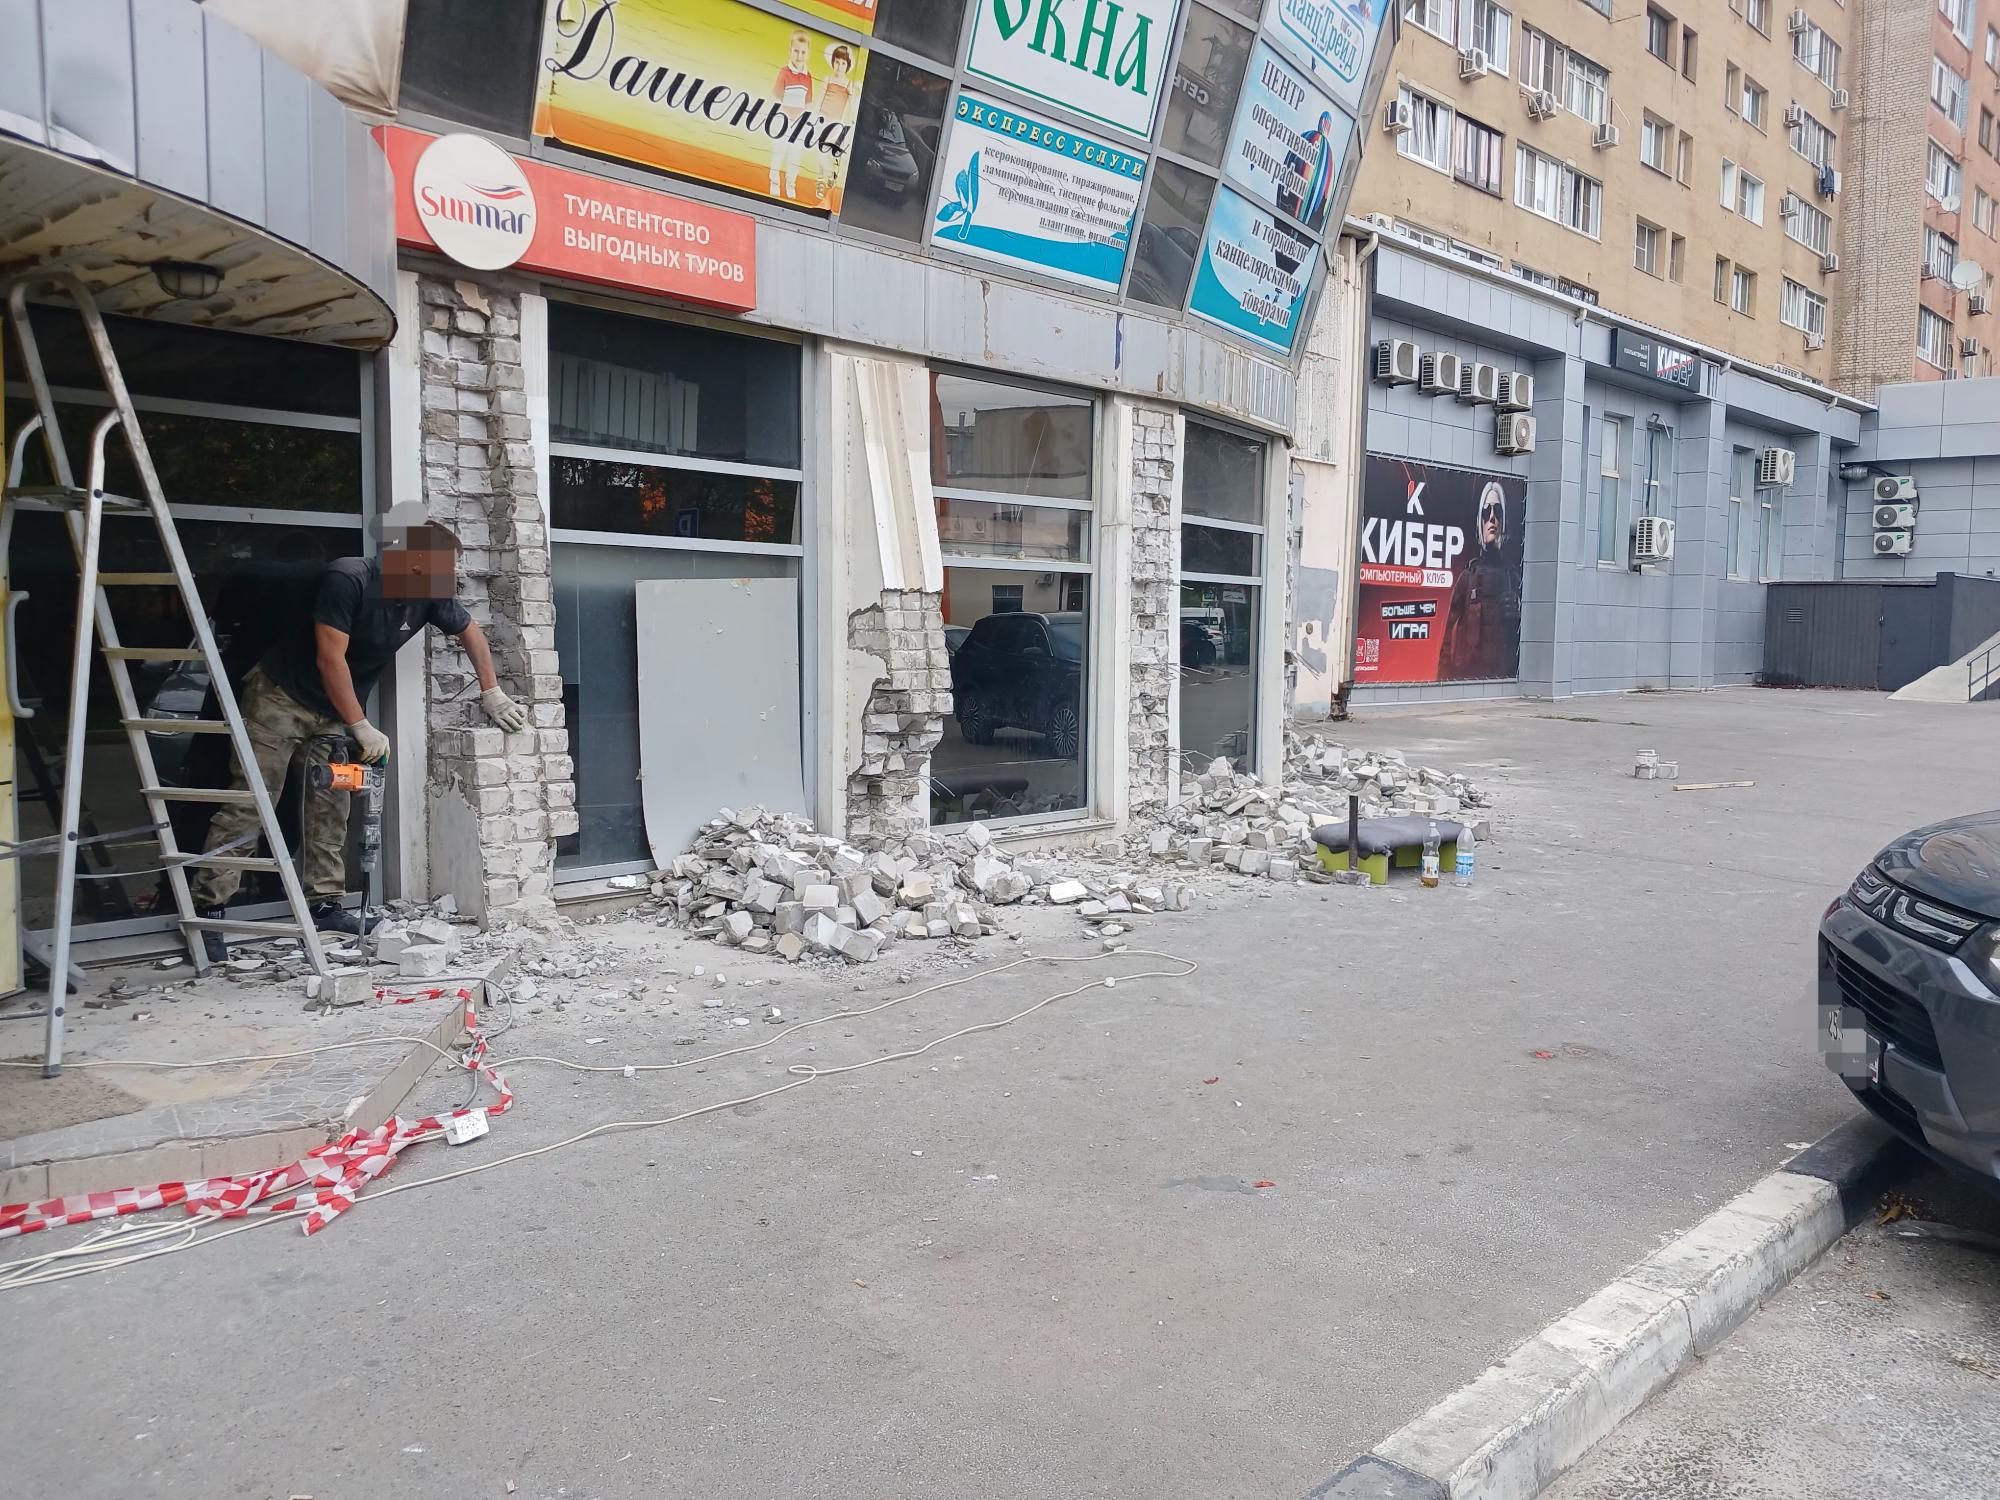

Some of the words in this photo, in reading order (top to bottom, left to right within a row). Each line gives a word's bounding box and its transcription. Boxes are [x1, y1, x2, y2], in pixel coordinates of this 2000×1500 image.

[545, 0, 851, 157] Дашенька
[1261, 59, 1305, 111] ЦЕНТР
[957, 101, 1065, 151] ЭКСПРЕСС
[1072, 140, 1145, 177] УСЛУГИ
[1252, 103, 1320, 166] оперативной
[982, 164, 1056, 195] ламинирование,
[1058, 187, 1096, 208] тиснение
[984, 146, 1069, 184] ксерокопирование,
[1071, 173, 1135, 203] тиражирование,
[1242, 139, 1308, 197] полиграфии
[421, 185, 531, 235] Sunmar
[563, 193, 711, 245] ТУРАГЕНТСТВО
[998, 185, 1069, 216] персонализация
[563, 226, 681, 270] ВЫГОДНЫХ
[684, 251, 745, 283] ТУРОВ
[1215, 239, 1300, 296] канцелярскими
[1262, 224, 1309, 263] торговли
[1241, 291, 1291, 326] товарами
[1360, 516, 1465, 569] КИБЕР
[1360, 568, 1422, 584] ОМПЬЮТЕРНЫЙ
[1426, 572, 1446, 584] КЛУБ
[1381, 604, 1416, 617] БОЛЬШЕ
[1419, 602, 1436, 613] ЧЕМ
[1391, 623, 1429, 639] ИГРА
